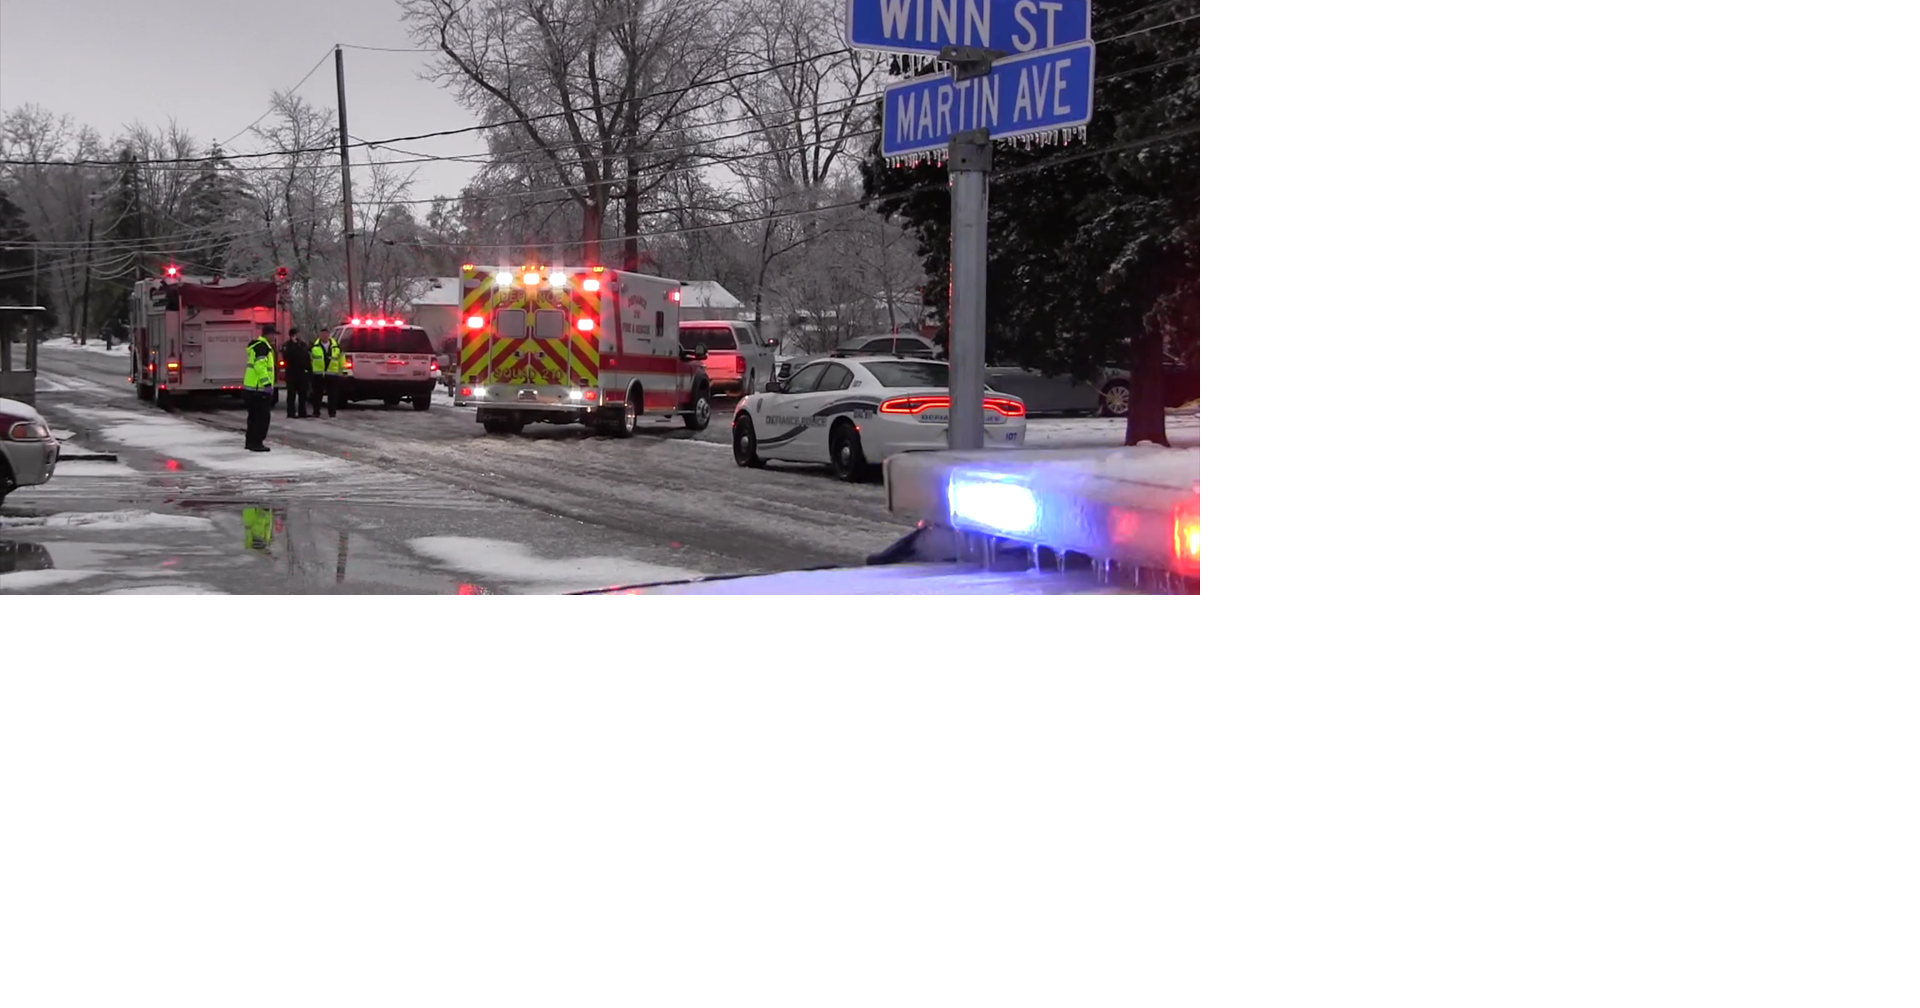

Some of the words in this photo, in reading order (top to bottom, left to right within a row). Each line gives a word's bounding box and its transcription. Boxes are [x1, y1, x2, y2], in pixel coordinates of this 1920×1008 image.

[880, 0, 990, 48] WINN
[1011, 0, 1062, 51] ST
[896, 74, 1000, 143] MARTIN
[1013, 58, 1072, 123] AVE
[765, 415, 800, 426] DEFIANCE
[801, 416, 827, 427] POLICE
[1005, 432, 1018, 441] 107
